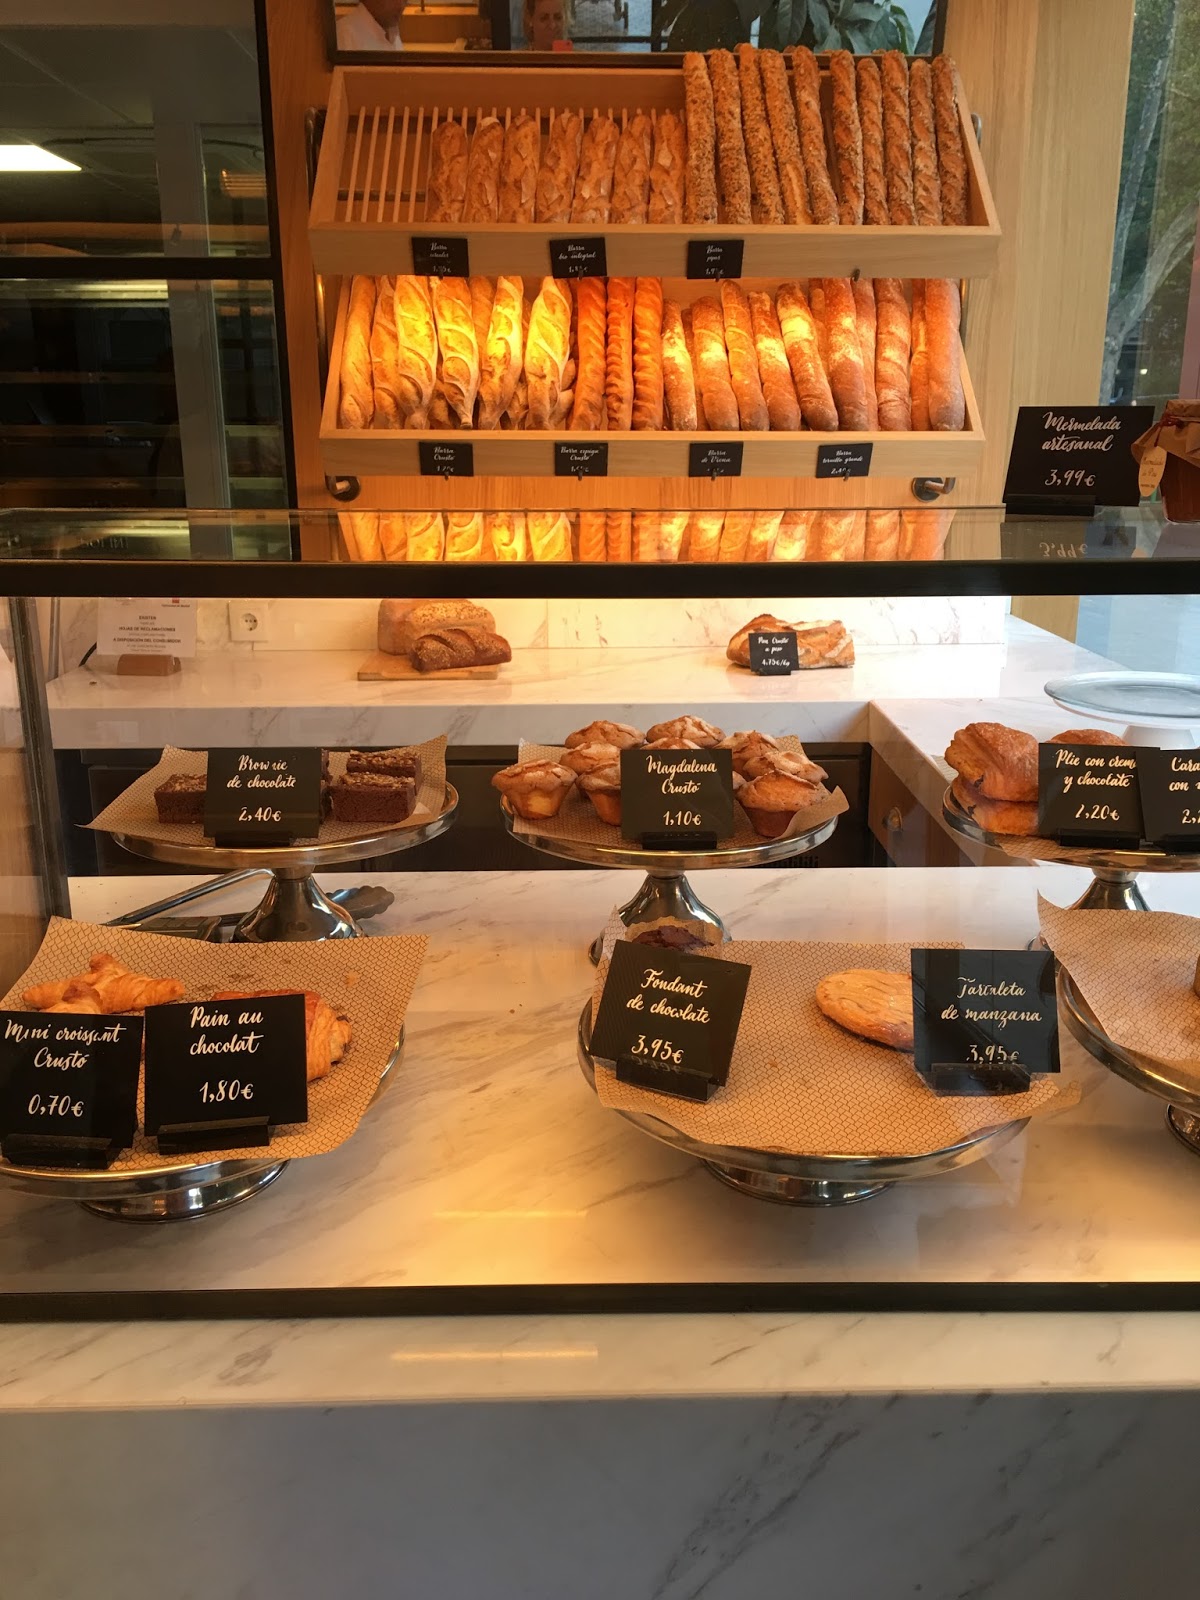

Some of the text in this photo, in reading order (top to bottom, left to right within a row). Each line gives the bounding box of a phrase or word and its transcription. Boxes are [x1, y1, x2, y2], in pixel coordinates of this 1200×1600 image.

[1042, 411, 1122, 432] Mermelada
[1041, 434, 1115, 452] artesanal
[1044, 468, 1096, 487] 3,99€
[758, 636, 769, 644] Pan
[646, 755, 718, 780] Magdalena
[1055, 749, 1080, 768] Plie
[1084, 757, 1106, 768] con
[226, 774, 297, 788] de chocolate
[1062, 771, 1134, 793] y chocolate
[1168, 782, 1190, 792] con
[238, 806, 282, 822] 2,40€
[663, 811, 702, 826] 1,10€
[1075, 804, 1120, 821] 1,20€
[640, 968, 708, 998] Fondant
[190, 1005, 264, 1028] Pain au
[626, 994, 710, 1024] de chocolate
[941, 1004, 1042, 1030] de manzana
[4, 1019, 52, 1043] Mini
[190, 1031, 264, 1056] chocolat
[631, 1034, 684, 1064] 3,95€
[966, 1044, 1020, 1064] 3,95€
[34, 1046, 90, 1071] Crustó
[199, 1079, 254, 1104] 1,80€
[28, 1094, 84, 1118] 0,70€
